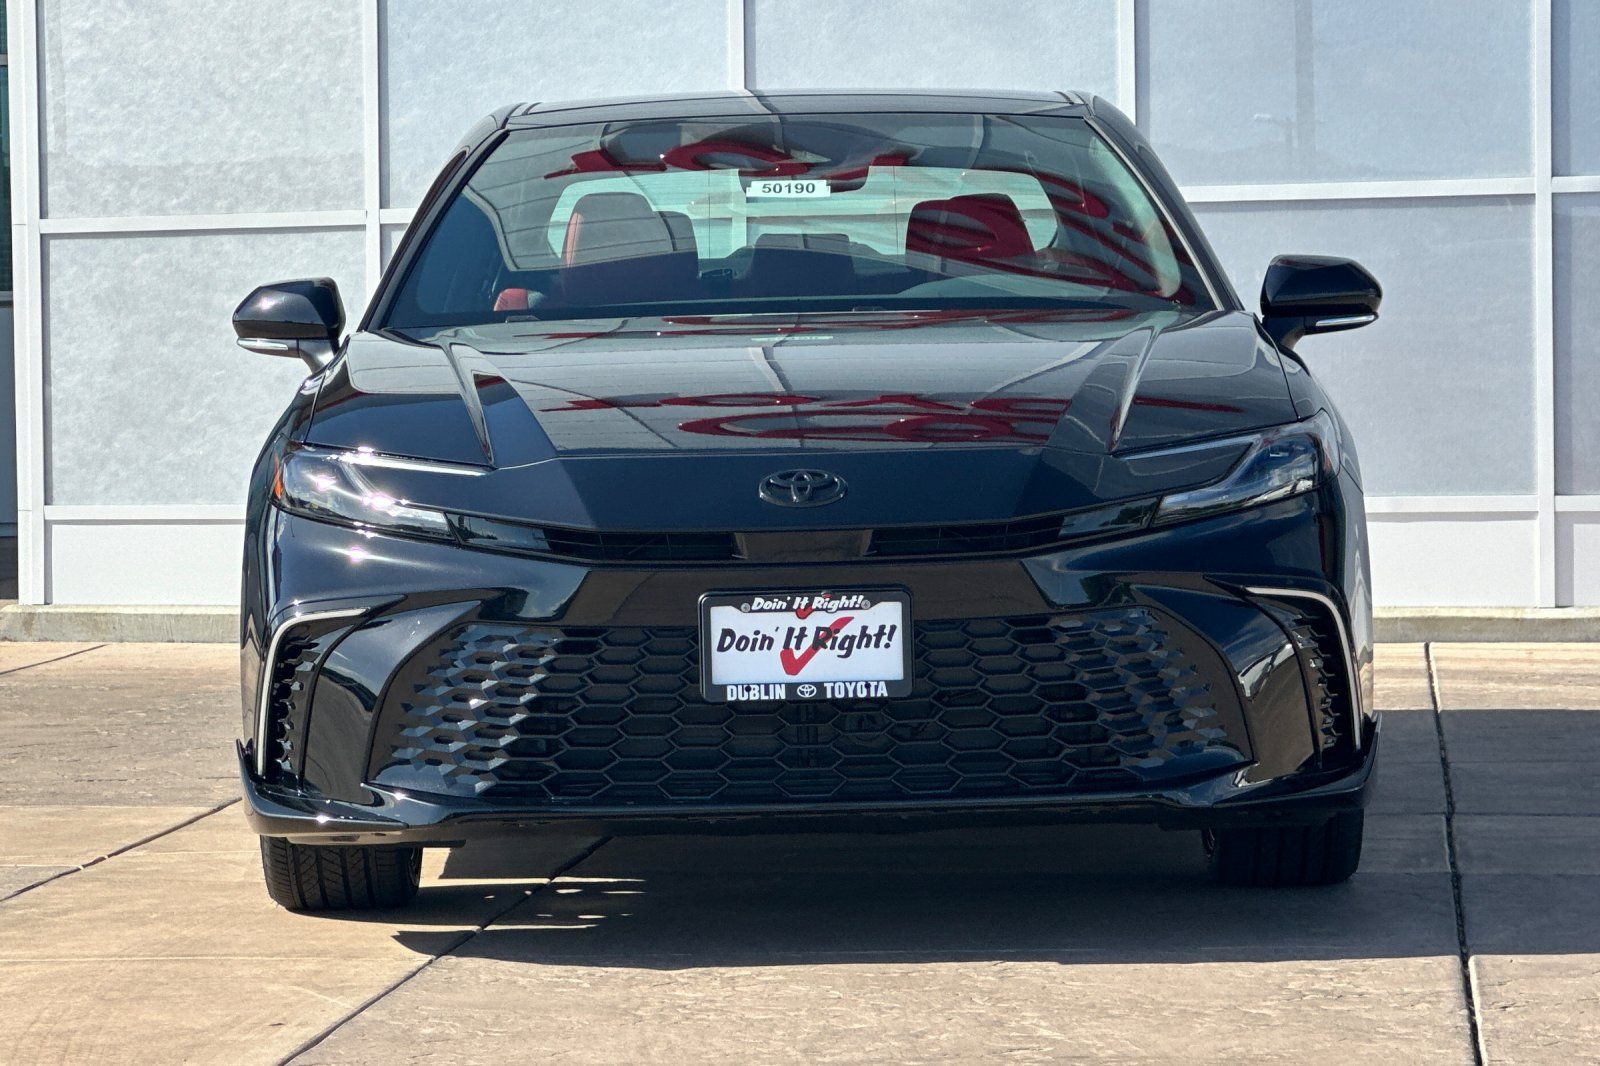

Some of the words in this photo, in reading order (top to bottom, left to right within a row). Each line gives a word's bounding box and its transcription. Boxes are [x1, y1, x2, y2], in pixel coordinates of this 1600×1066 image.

[762, 183, 816, 194] 50190
[752, 596, 791, 611] Doin'
[793, 595, 808, 610] It
[811, 594, 862, 613] Right!
[717, 627, 779, 652] Doin'
[783, 626, 808, 651] It
[812, 624, 898, 658] Right!
[726, 685, 786, 701] DUBLIN
[824, 682, 888, 698] TOYOTA
